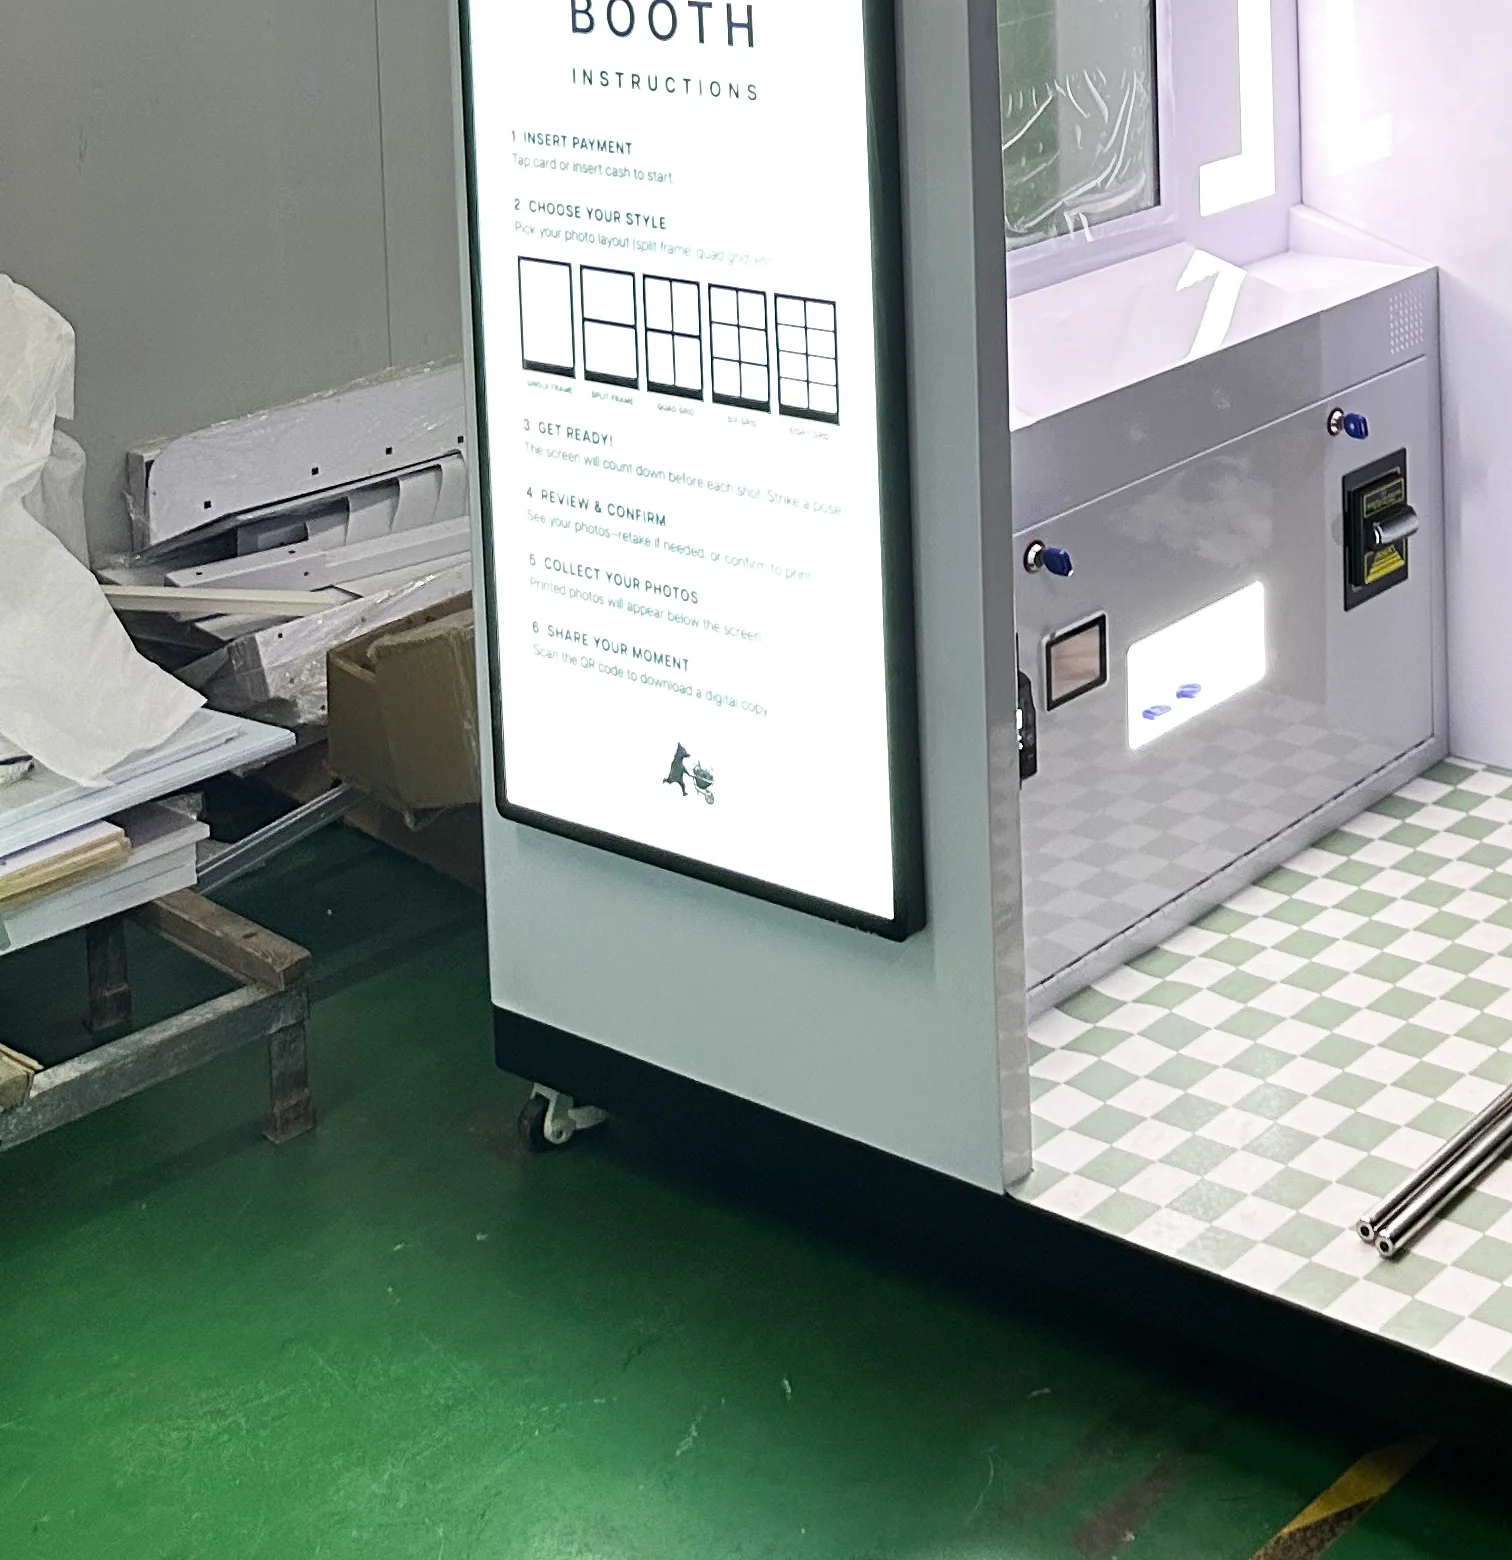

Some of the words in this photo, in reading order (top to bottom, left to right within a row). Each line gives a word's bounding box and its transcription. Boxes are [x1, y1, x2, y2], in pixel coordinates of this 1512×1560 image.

[572, 67, 759, 101] INSTRUCTIONS
[523, 131, 567, 148] INSERT
[572, 136, 633, 155] PAYMENT
[512, 153, 530, 168] Tap
[533, 157, 556, 170] card
[559, 161, 569, 171] or
[573, 161, 603, 175] insert
[605, 165, 630, 178] cash
[633, 168, 644, 180] to
[528, 200, 582, 219] CHOOSE
[586, 207, 621, 224] YOUR
[626, 212, 666, 230] STYLE
[514, 221, 536, 235] Pick
[539, 227, 561, 239] your
[564, 229, 595, 243] photo
[597, 232, 630, 248] layout
[611, 394, 634, 405] FRAME
[538, 421, 561, 436] GET
[566, 426, 613, 447] READY!
[524, 441, 543, 456] The
[546, 448, 580, 463] screen
[583, 455, 600, 467] will
[602, 459, 632, 474] count
[635, 465, 665, 479] down
[668, 470, 704, 489] before
[707, 479, 733, 493] each
[803, 500, 810, 510] a
[541, 488, 589, 510] REVIEW
[594, 500, 602, 513] &
[607, 502, 666, 526] CONFIRM
[527, 509, 546, 523] See
[549, 516, 571, 529] your
[710, 551, 720, 562] or
[770, 563, 782, 575] to
[544, 557, 600, 580] COLLECT
[605, 571, 640, 590] YOUR
[645, 580, 699, 604] PHOTOS
[530, 576, 566, 595] Printed
[569, 587, 604, 605] photos
[607, 597, 624, 609] will
[627, 601, 664, 617] appear
[667, 609, 699, 627] below
[703, 619, 720, 632] the
[547, 624, 589, 646] SHARE
[593, 635, 628, 656] YOUR
[632, 645, 689, 672] MOMENT
[533, 643, 558, 659] Scan
[561, 651, 578, 665] the
[580, 656, 595, 669] QR
[598, 663, 624, 678] code
[627, 669, 638, 681] to
[640, 673, 693, 696] download
[695, 689, 702, 698] a
[705, 690, 737, 707] digital
